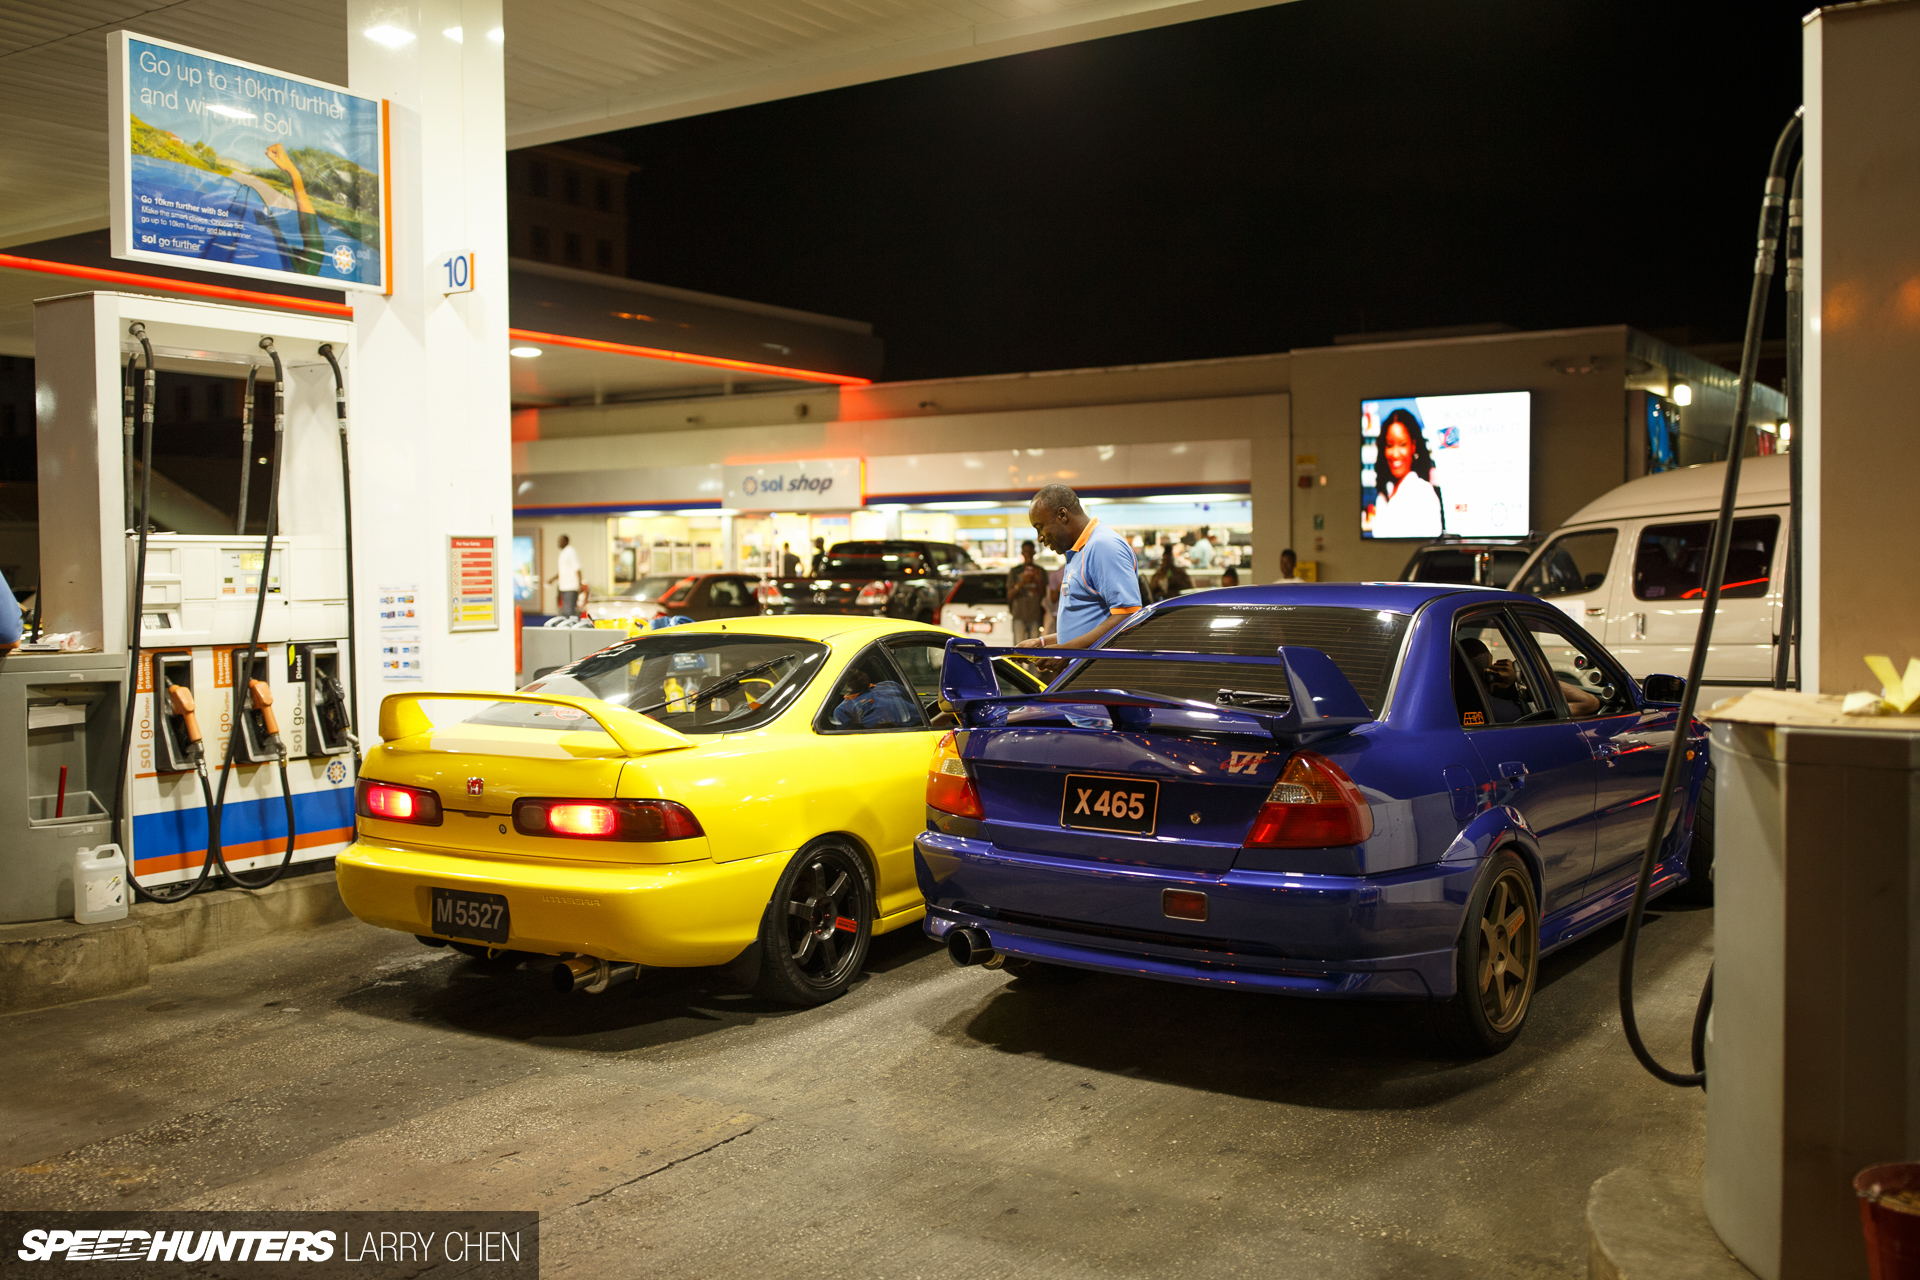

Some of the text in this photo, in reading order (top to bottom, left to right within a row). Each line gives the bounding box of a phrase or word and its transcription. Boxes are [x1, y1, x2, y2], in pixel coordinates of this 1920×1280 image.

[139, 51, 346, 120] Go up to 10km further
[140, 87, 178, 110] and
[185, 97, 217, 119] win
[263, 112, 292, 136] Sol
[141, 195, 229, 218] Go 10km further with Sol
[141, 206, 159, 216] Make
[160, 209, 170, 217] the
[141, 216, 150, 225] go
[151, 217, 159, 226] up
[168, 220, 185, 228] 10km
[186, 222, 205, 231] further
[206, 227, 219, 235] and
[141, 234, 157, 244] sol
[158, 238, 171, 248] go
[172, 239, 201, 252] further
[443, 255, 468, 288] 10
[760, 473, 834, 496] sol shop
[144, 656, 152, 689] gasoline
[220, 713, 232, 733] go
[293, 706, 304, 726] go
[140, 719, 154, 740] go
[291, 730, 302, 753] sol
[137, 743, 151, 769] sol
[1227, 751, 1268, 775] VI
[1073, 788, 1146, 820] X465
[542, 895, 602, 907] INTEGRA
[436, 897, 504, 930] M5527
